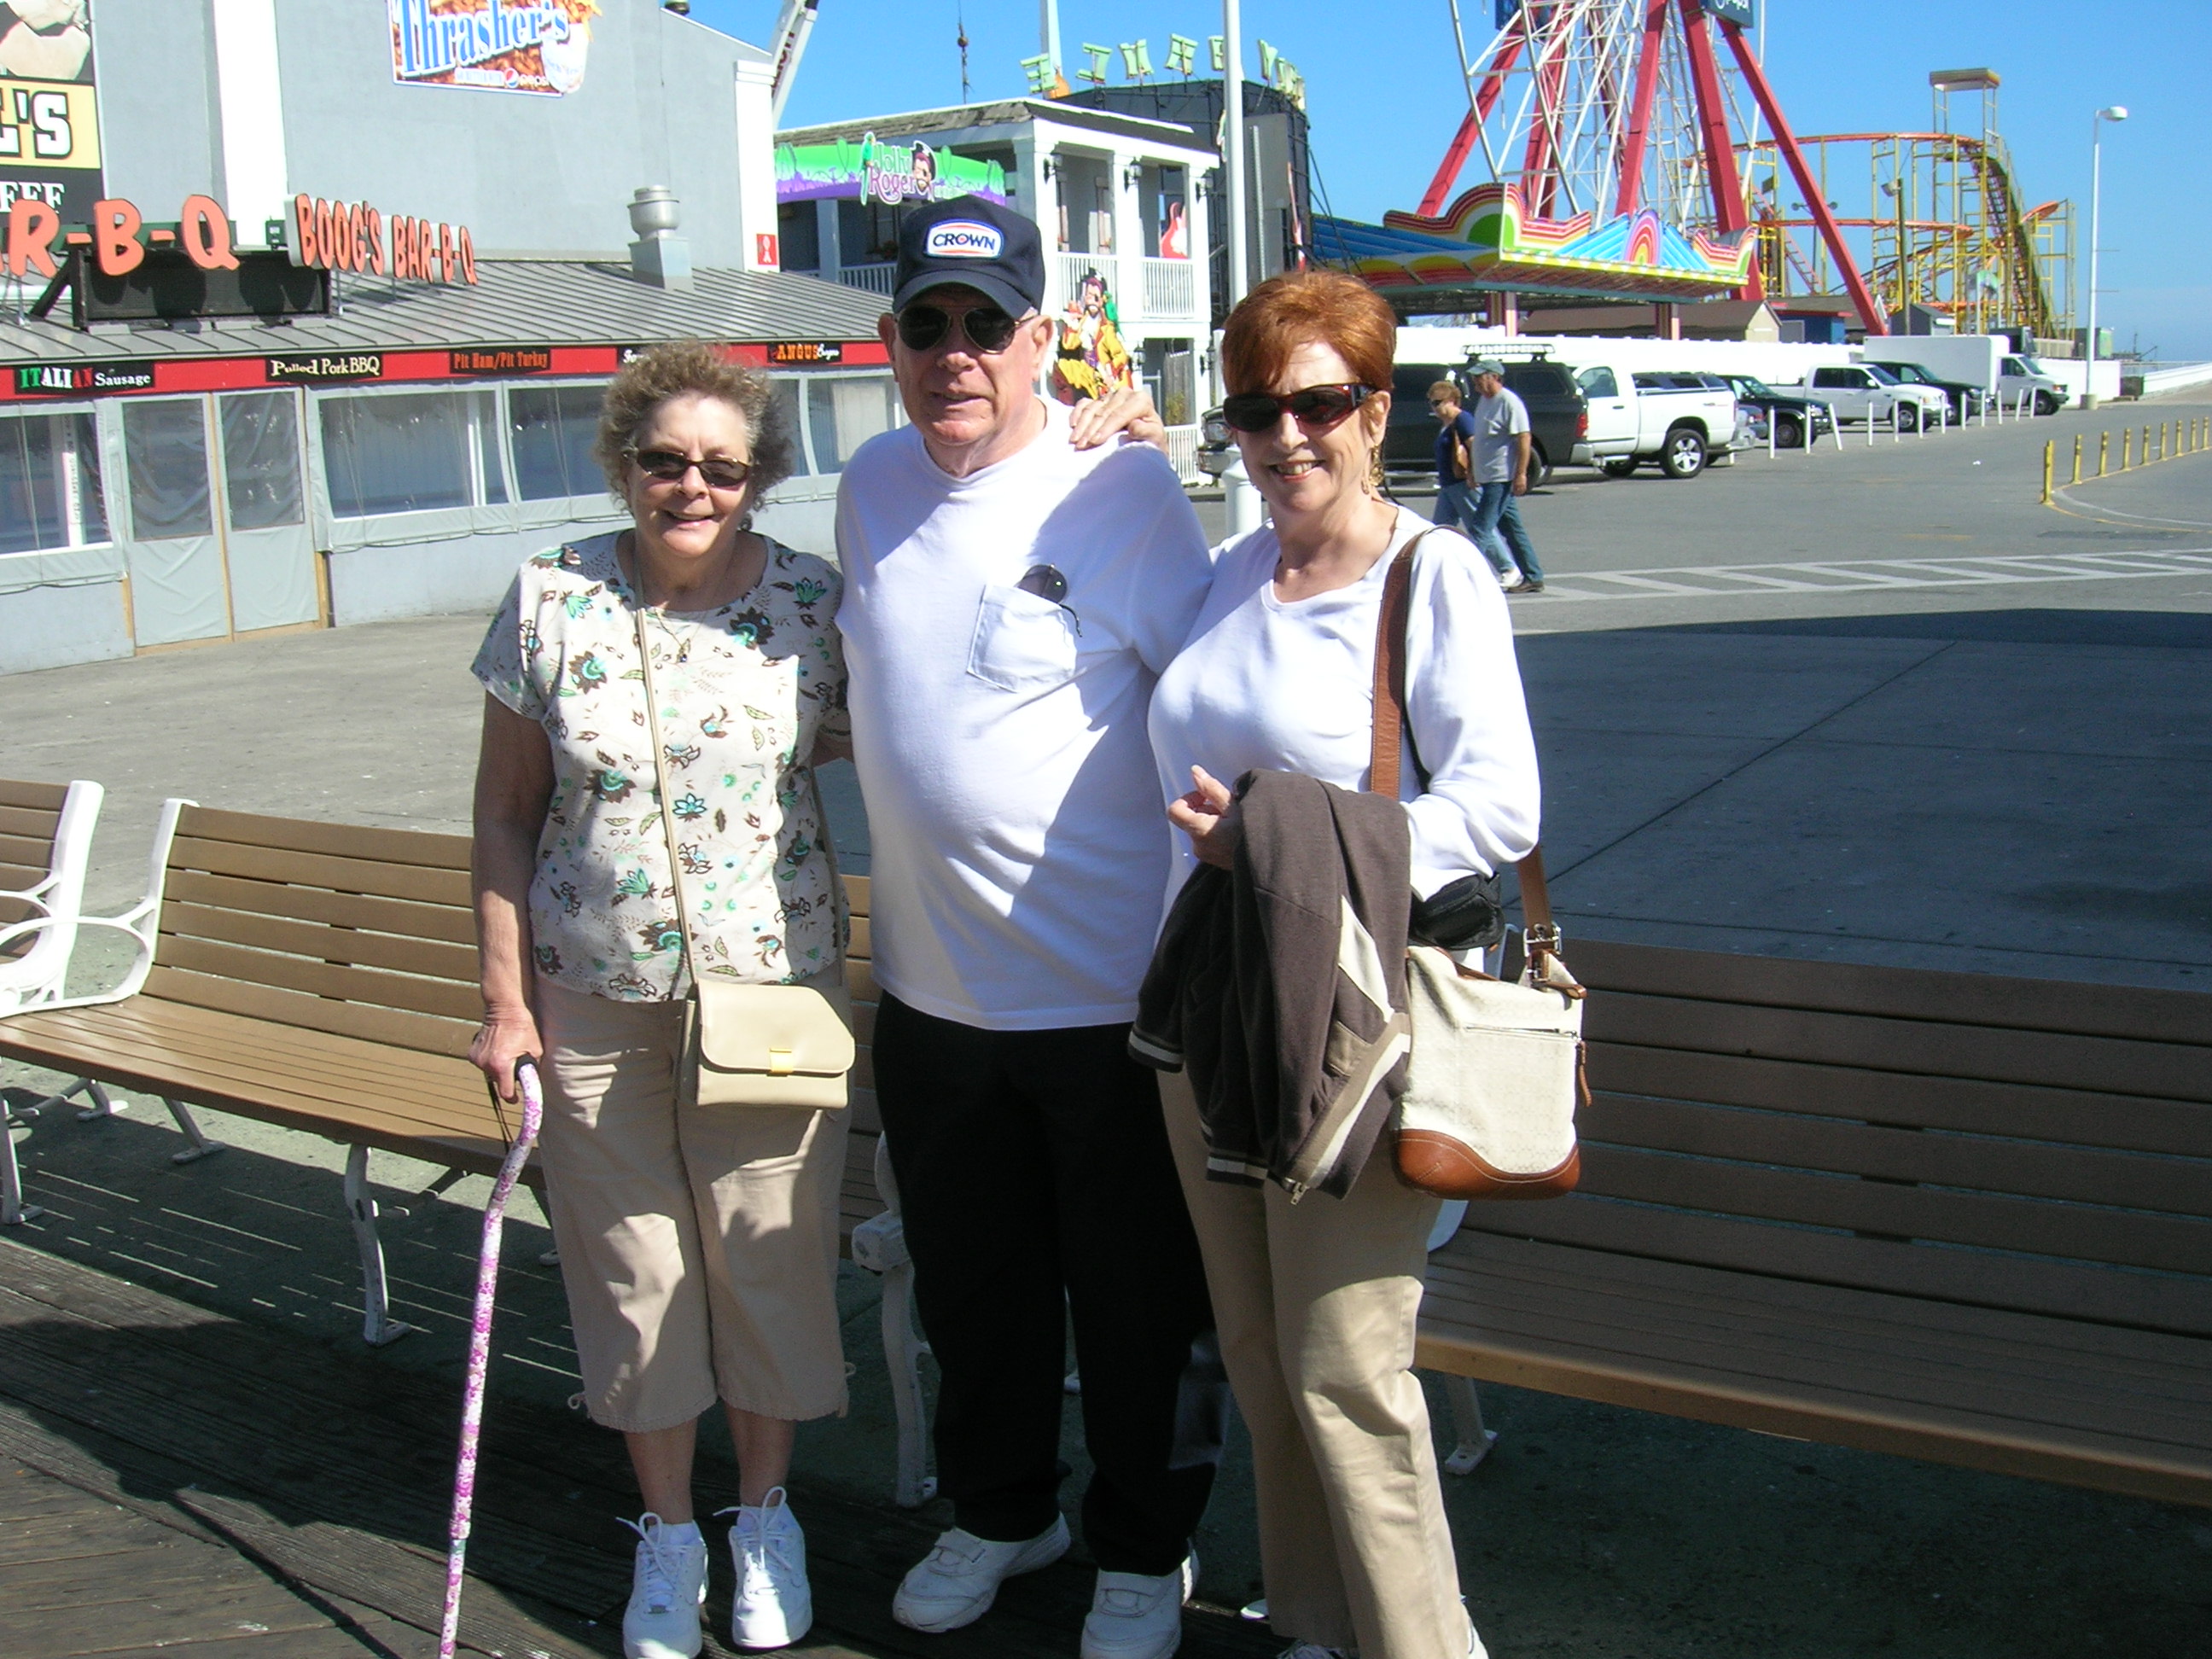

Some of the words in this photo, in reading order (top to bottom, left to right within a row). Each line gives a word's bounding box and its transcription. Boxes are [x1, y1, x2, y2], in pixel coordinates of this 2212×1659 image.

[393, 0, 570, 76] Thrasher's
[869, 165, 917, 204] Roger
[0, 194, 241, 279] R-B-Q
[295, 193, 385, 276] BOOG'S
[392, 214, 479, 285] BAR-B-Q
[933, 233, 995, 250] CROWN
[270, 359, 320, 376] Pulled
[321, 358, 349, 375] Pork
[349, 355, 380, 375] BBQ
[777, 343, 818, 360] ANGUS
[20, 366, 94, 389] ITALIAN
[95, 371, 152, 387] Sausage
